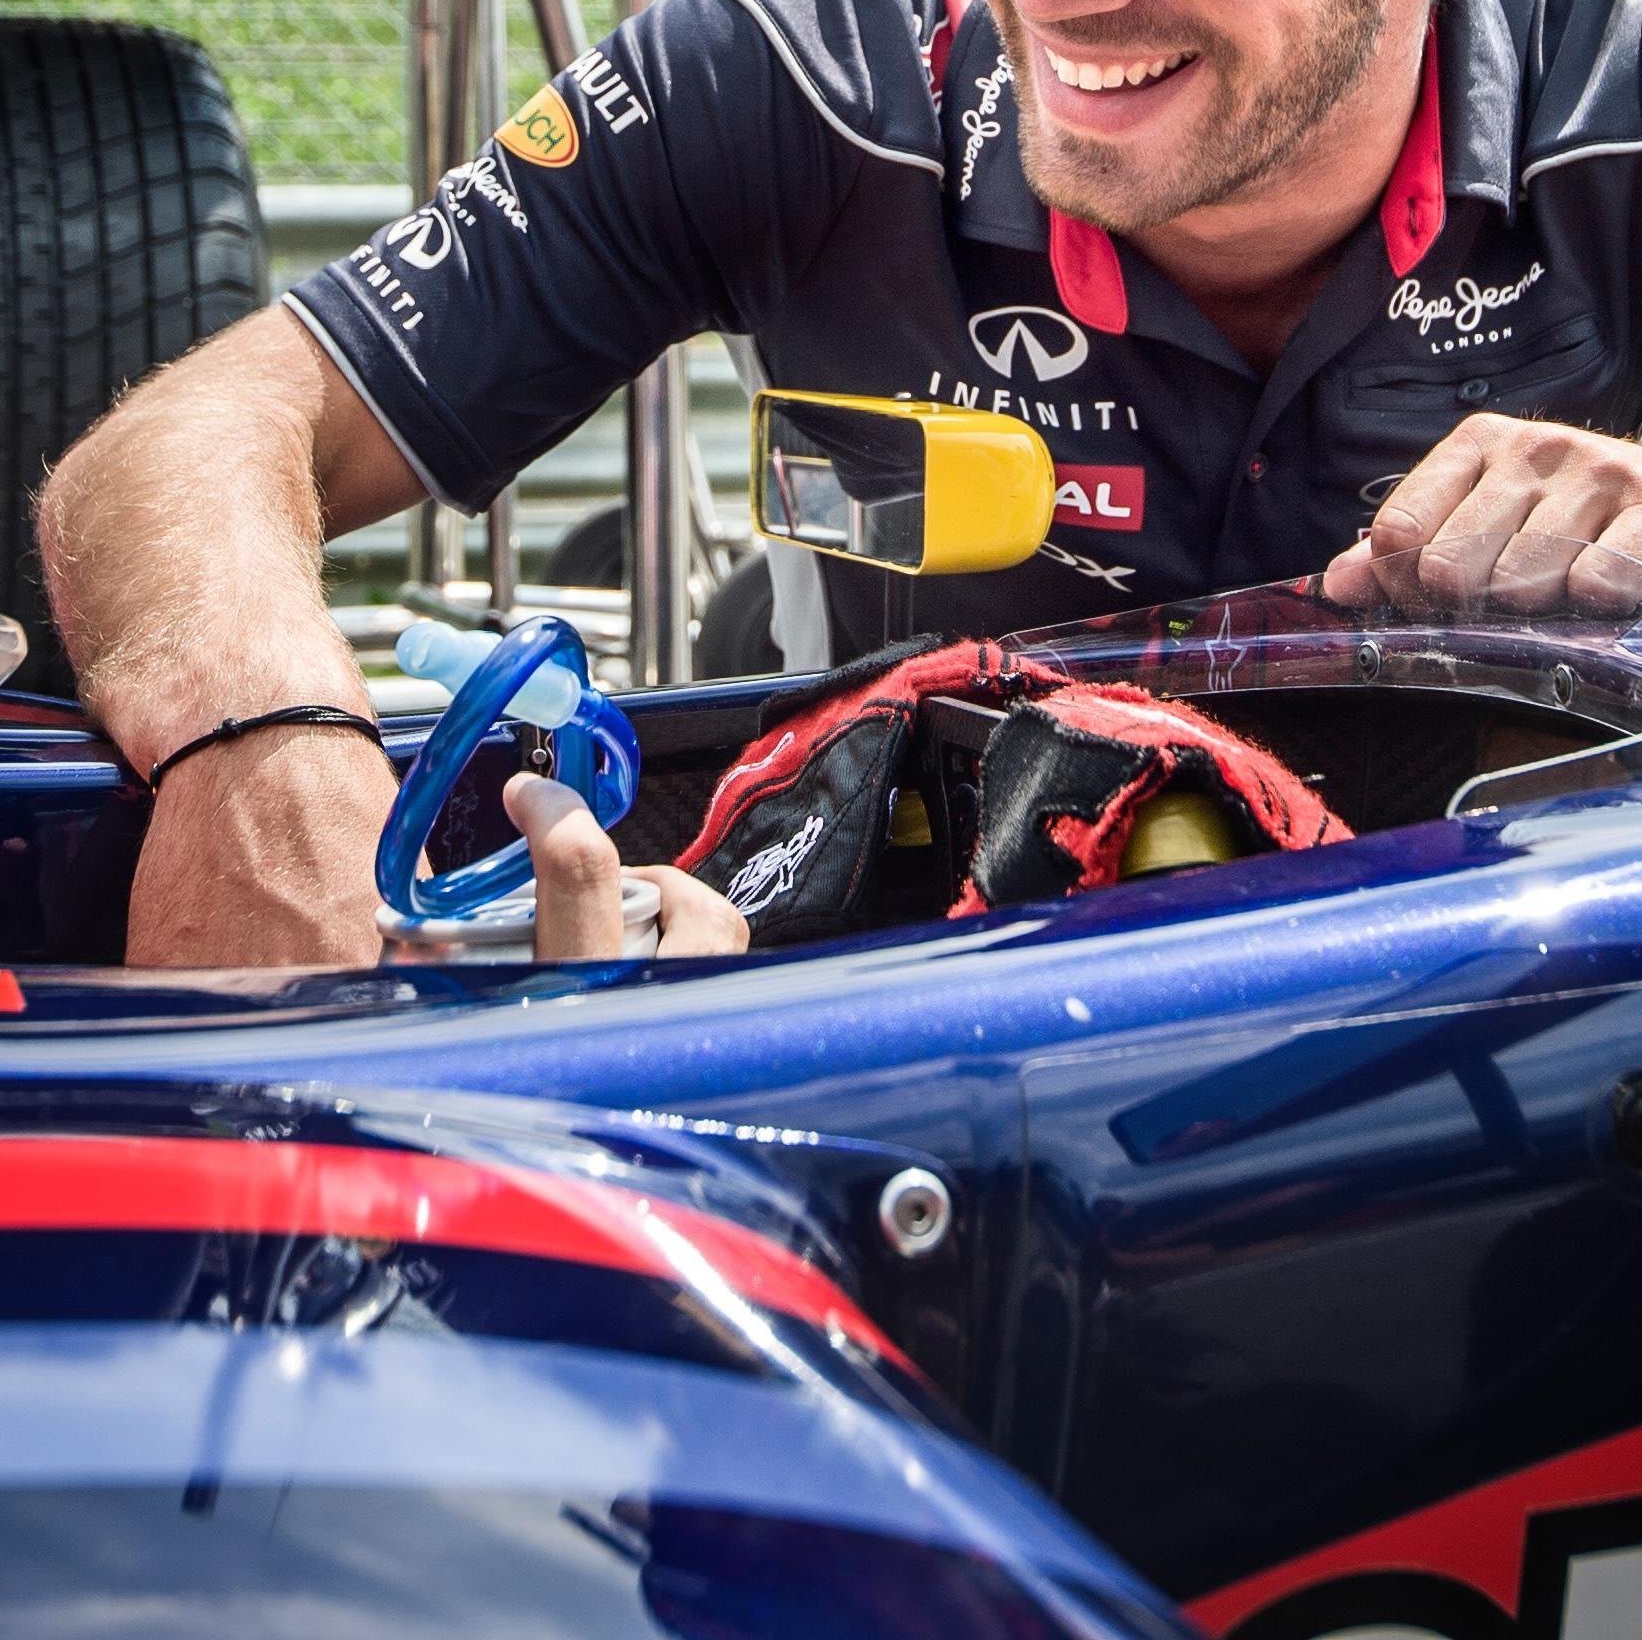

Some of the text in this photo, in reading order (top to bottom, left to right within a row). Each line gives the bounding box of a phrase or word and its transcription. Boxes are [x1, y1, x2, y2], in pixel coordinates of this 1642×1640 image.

[565, 46, 650, 135] AULT
[962, 110, 1001, 201] Jeans
[1388, 261, 1546, 337] Pepe Jeans
[1431, 326, 1513, 355] LONDON
[928, 370, 1139, 431] INFINITI
